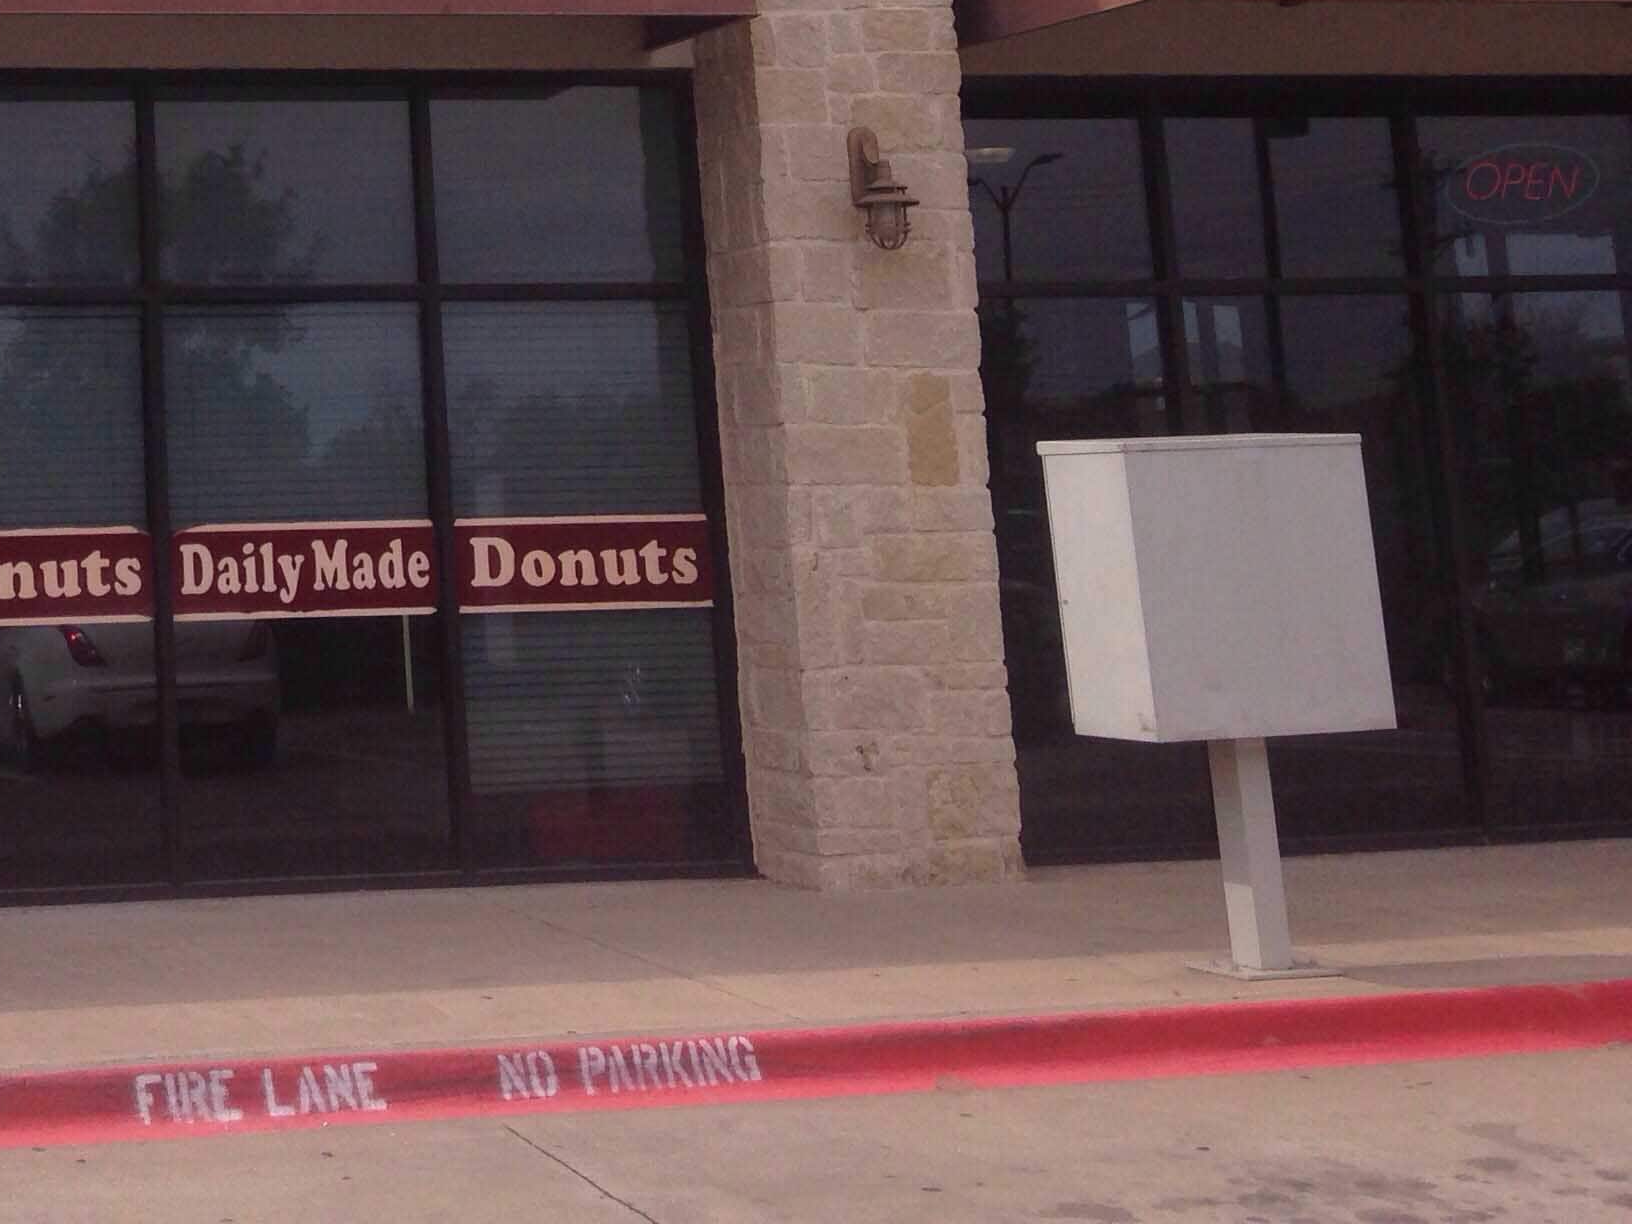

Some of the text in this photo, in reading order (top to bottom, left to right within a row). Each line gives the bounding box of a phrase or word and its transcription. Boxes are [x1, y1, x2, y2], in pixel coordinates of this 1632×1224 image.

[1466, 160, 1582, 200] OPEN
[470, 536, 699, 589] Donuts
[132, 1061, 388, 1126] FIRE LANE
[495, 1034, 763, 1101] NO PARKING
